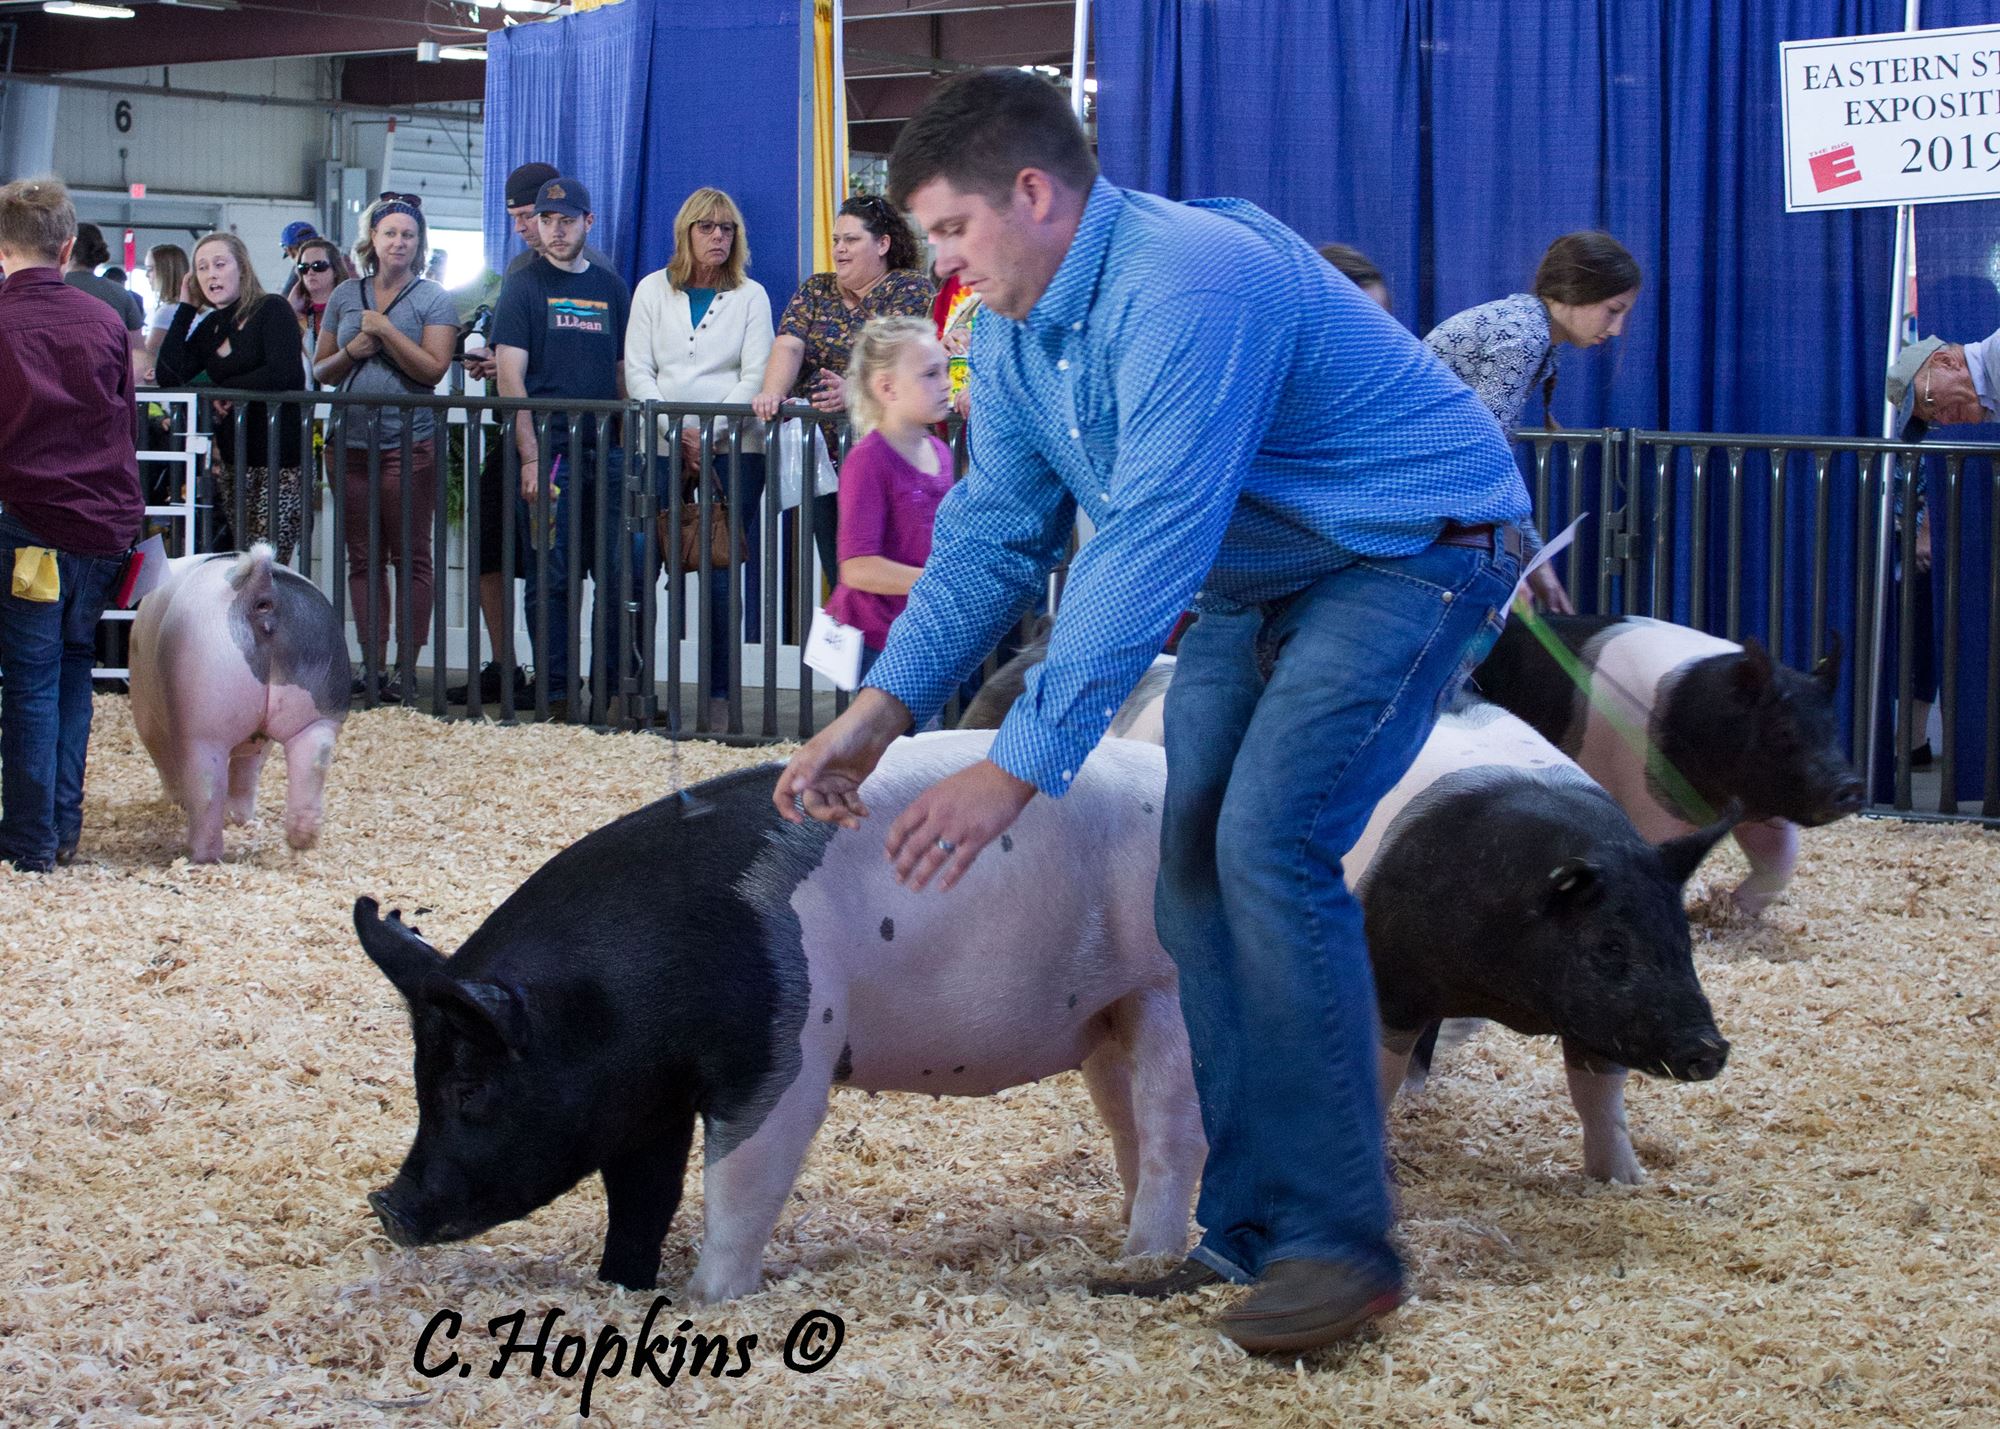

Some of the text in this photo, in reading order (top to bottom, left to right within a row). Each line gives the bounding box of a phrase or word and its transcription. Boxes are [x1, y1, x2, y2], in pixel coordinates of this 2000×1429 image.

[1802, 54, 1960, 91] EASTERN
[115, 100, 132, 133] 6
[1808, 145, 1862, 193] E
[1900, 131, 2000, 174] 2019
